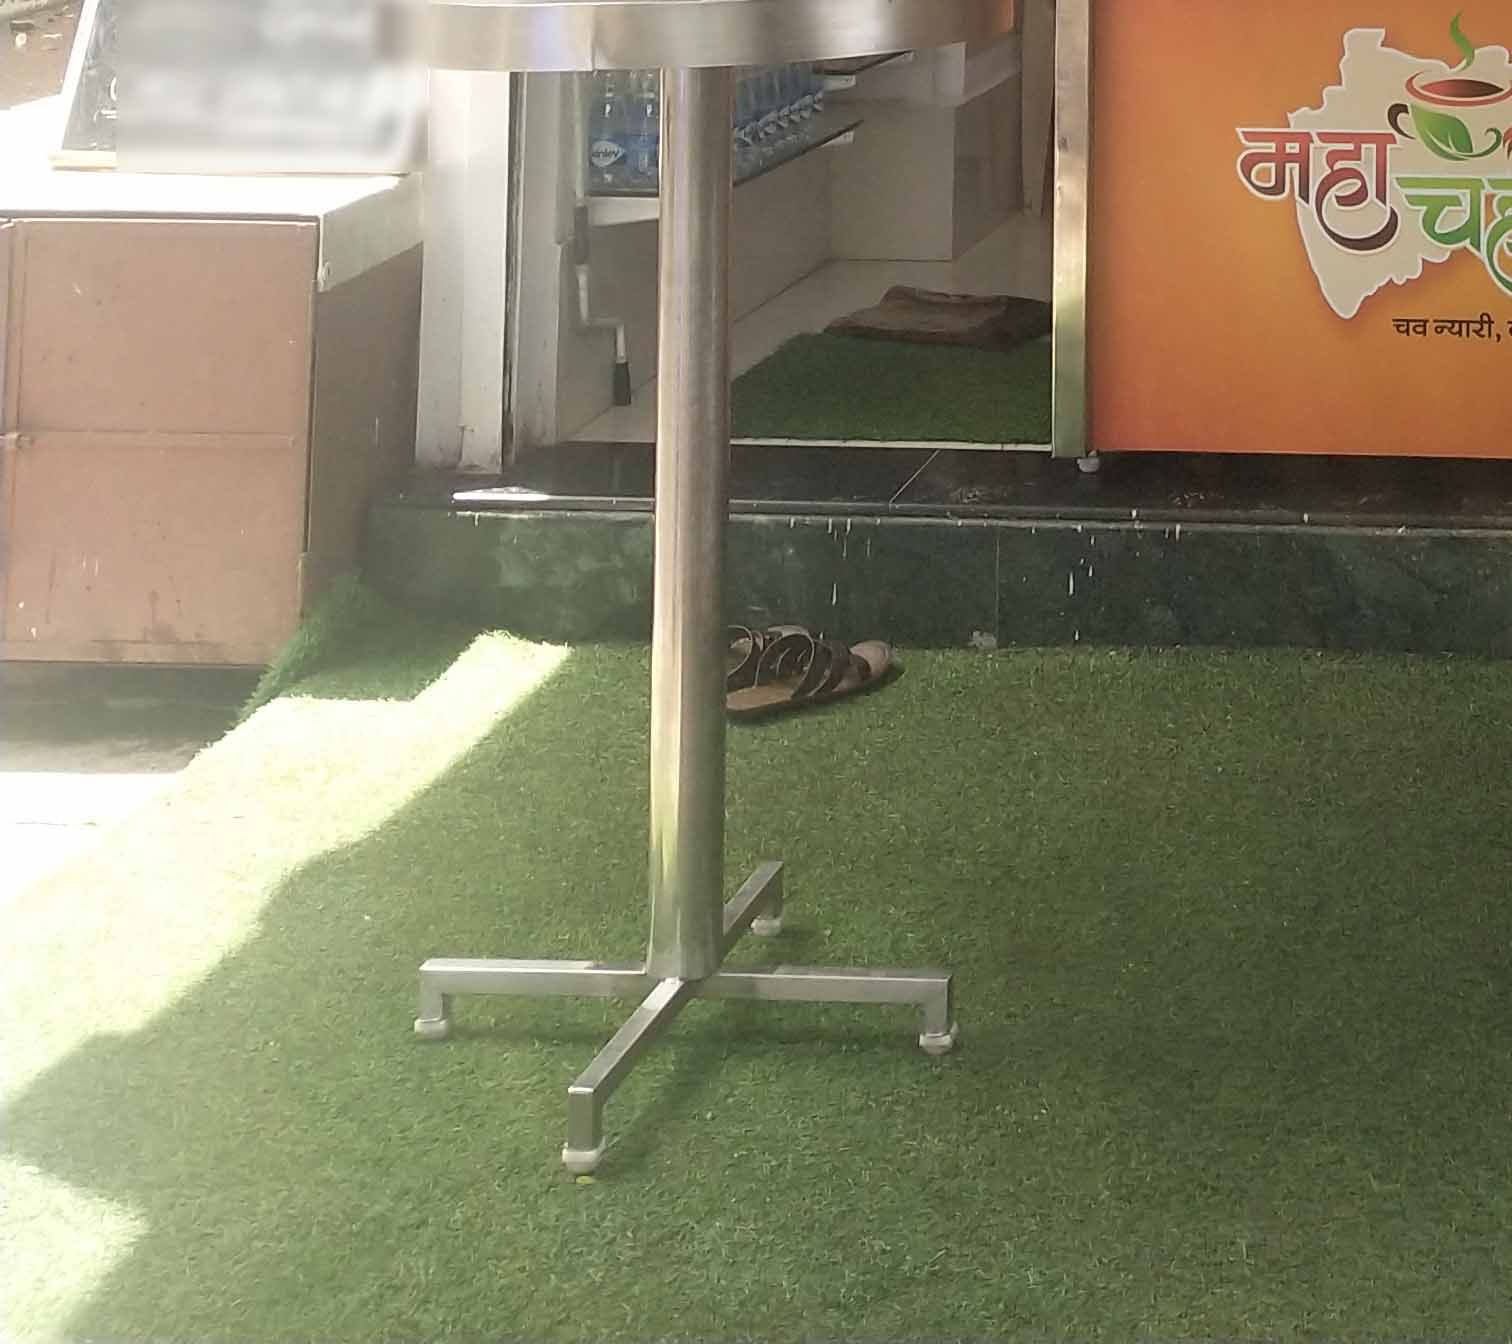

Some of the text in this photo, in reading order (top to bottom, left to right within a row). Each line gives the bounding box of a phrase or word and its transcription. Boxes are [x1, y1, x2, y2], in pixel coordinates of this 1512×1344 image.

[1236, 127, 1398, 253] महा
[1392, 318, 1429, 337] चव
[1433, 312, 1502, 343] न्यारी,
